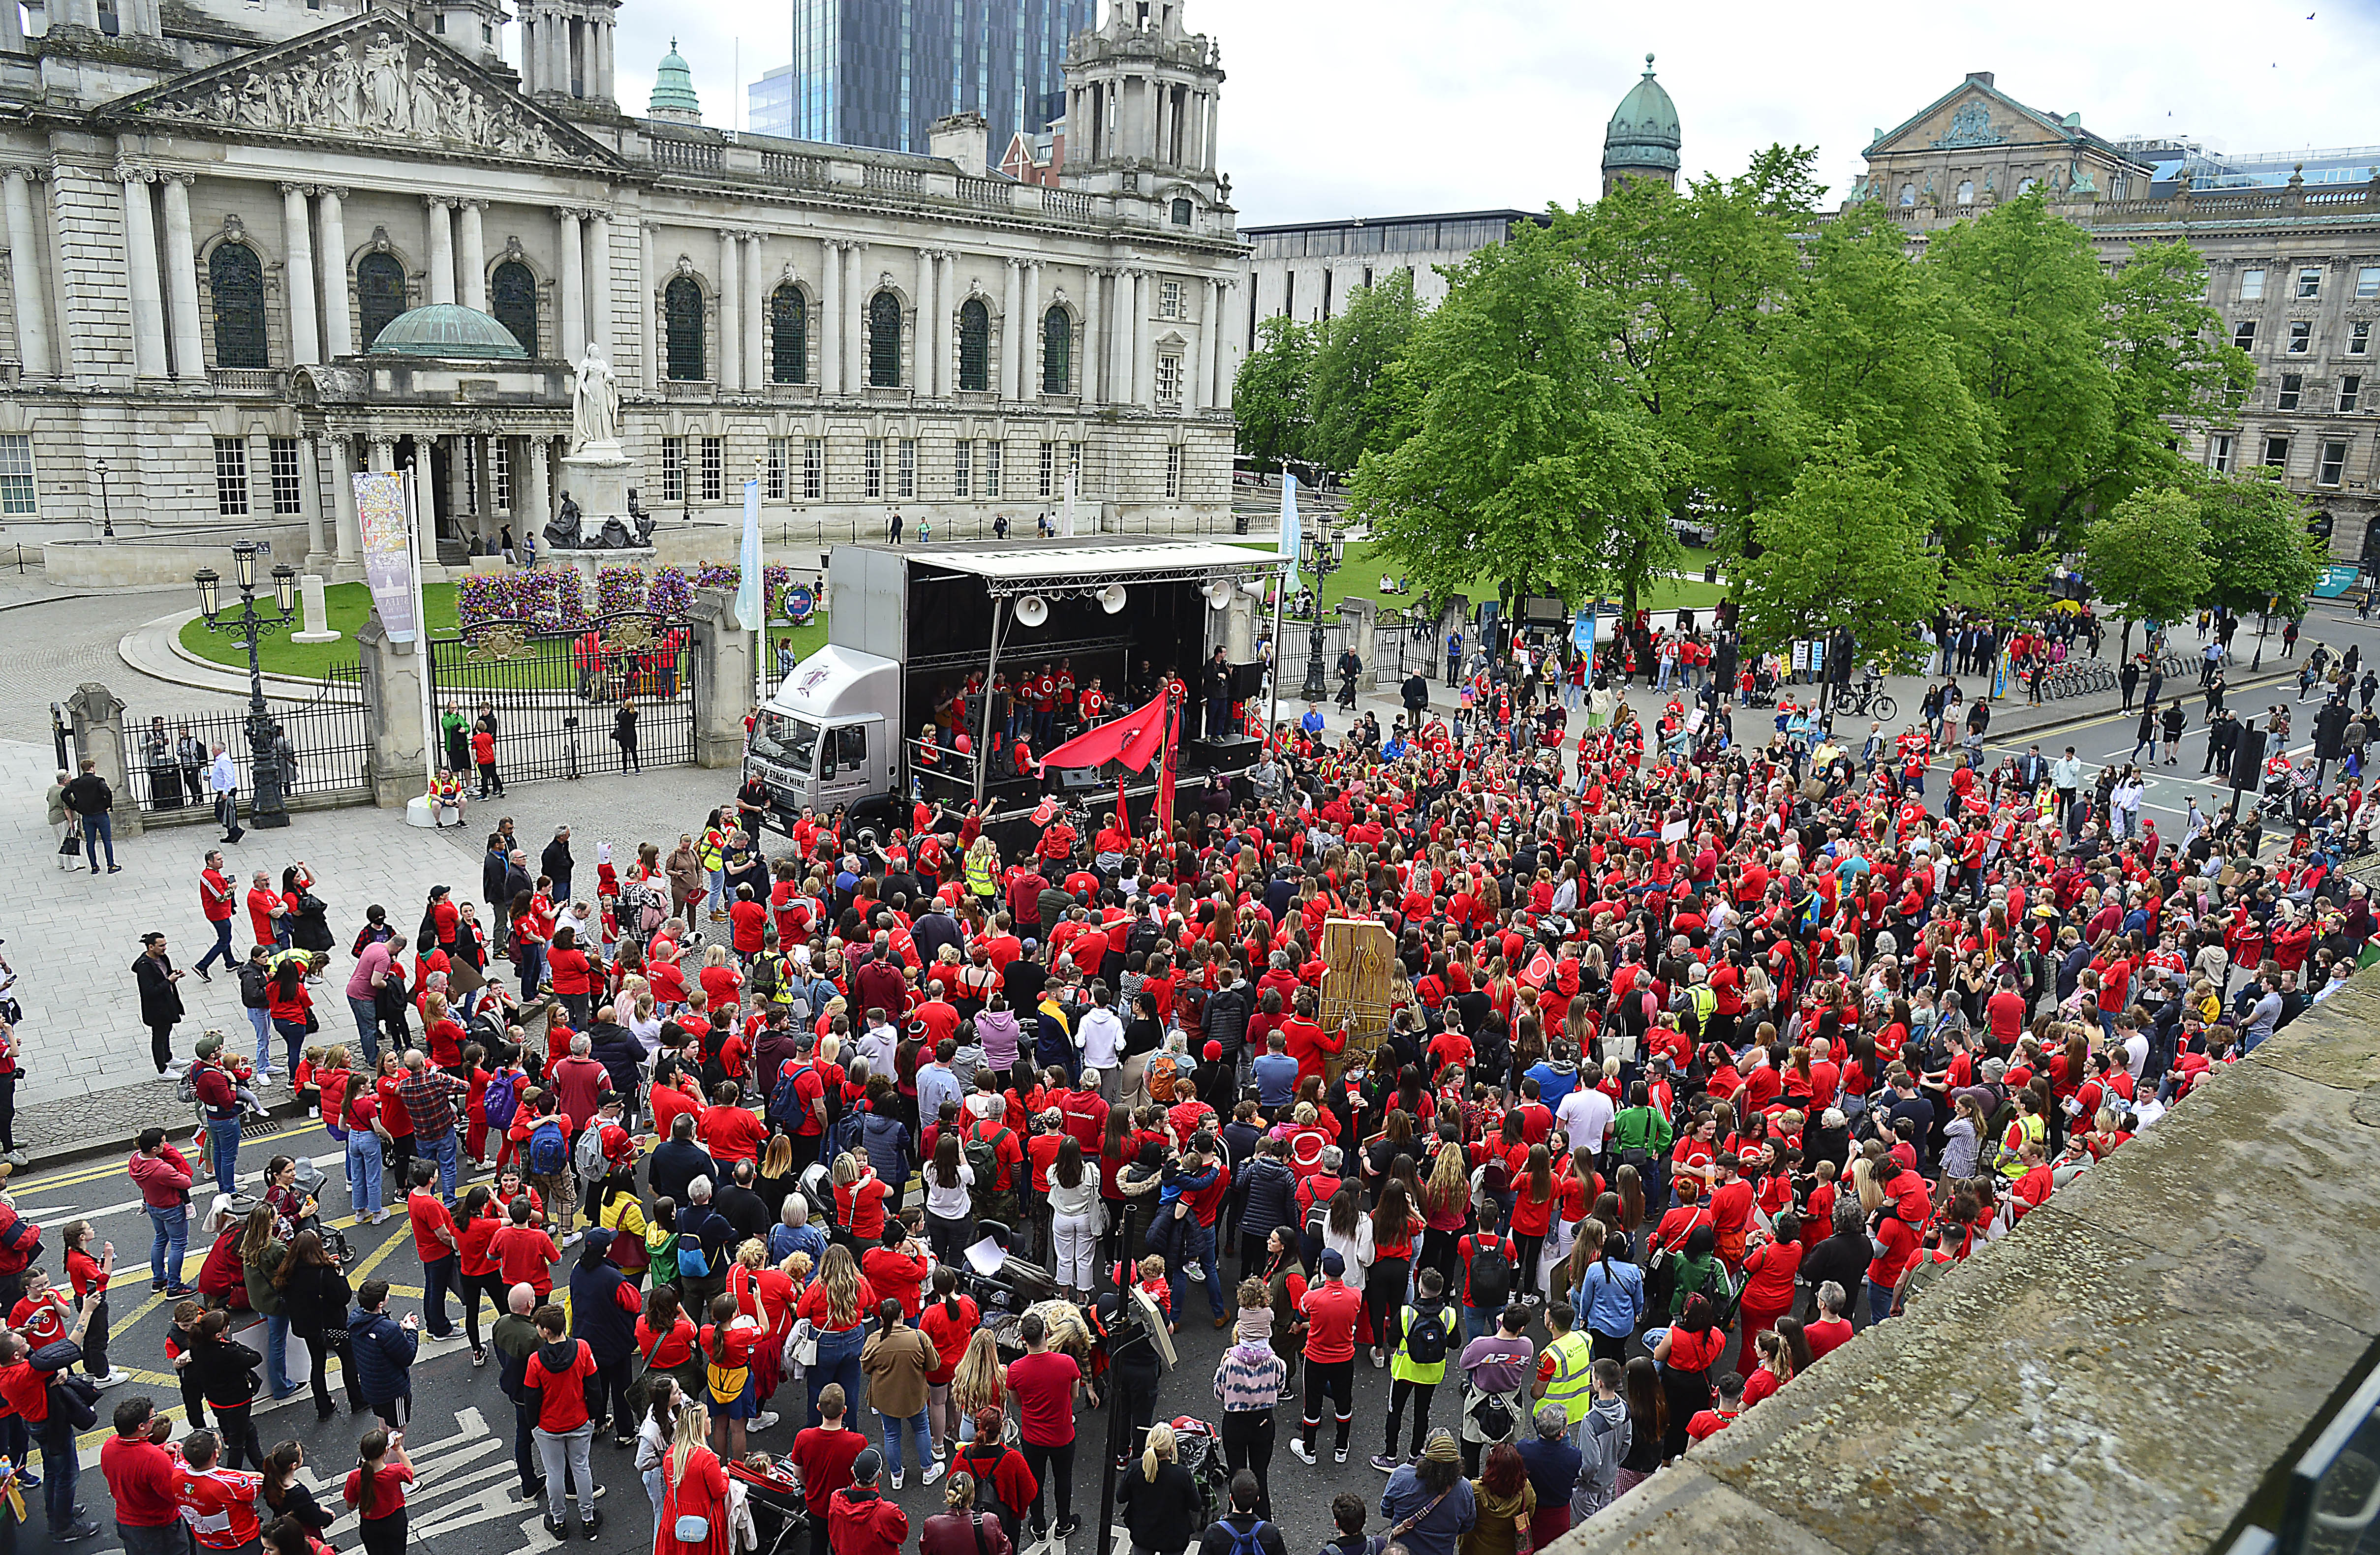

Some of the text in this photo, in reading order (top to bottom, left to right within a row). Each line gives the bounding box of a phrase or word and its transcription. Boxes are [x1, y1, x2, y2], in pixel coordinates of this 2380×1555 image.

[769, 769, 788, 783] STAGE
[789, 776, 805, 789] HIRE
[1066, 1110, 1094, 1120] Criminology
[1480, 1353, 1530, 1366] APEX
